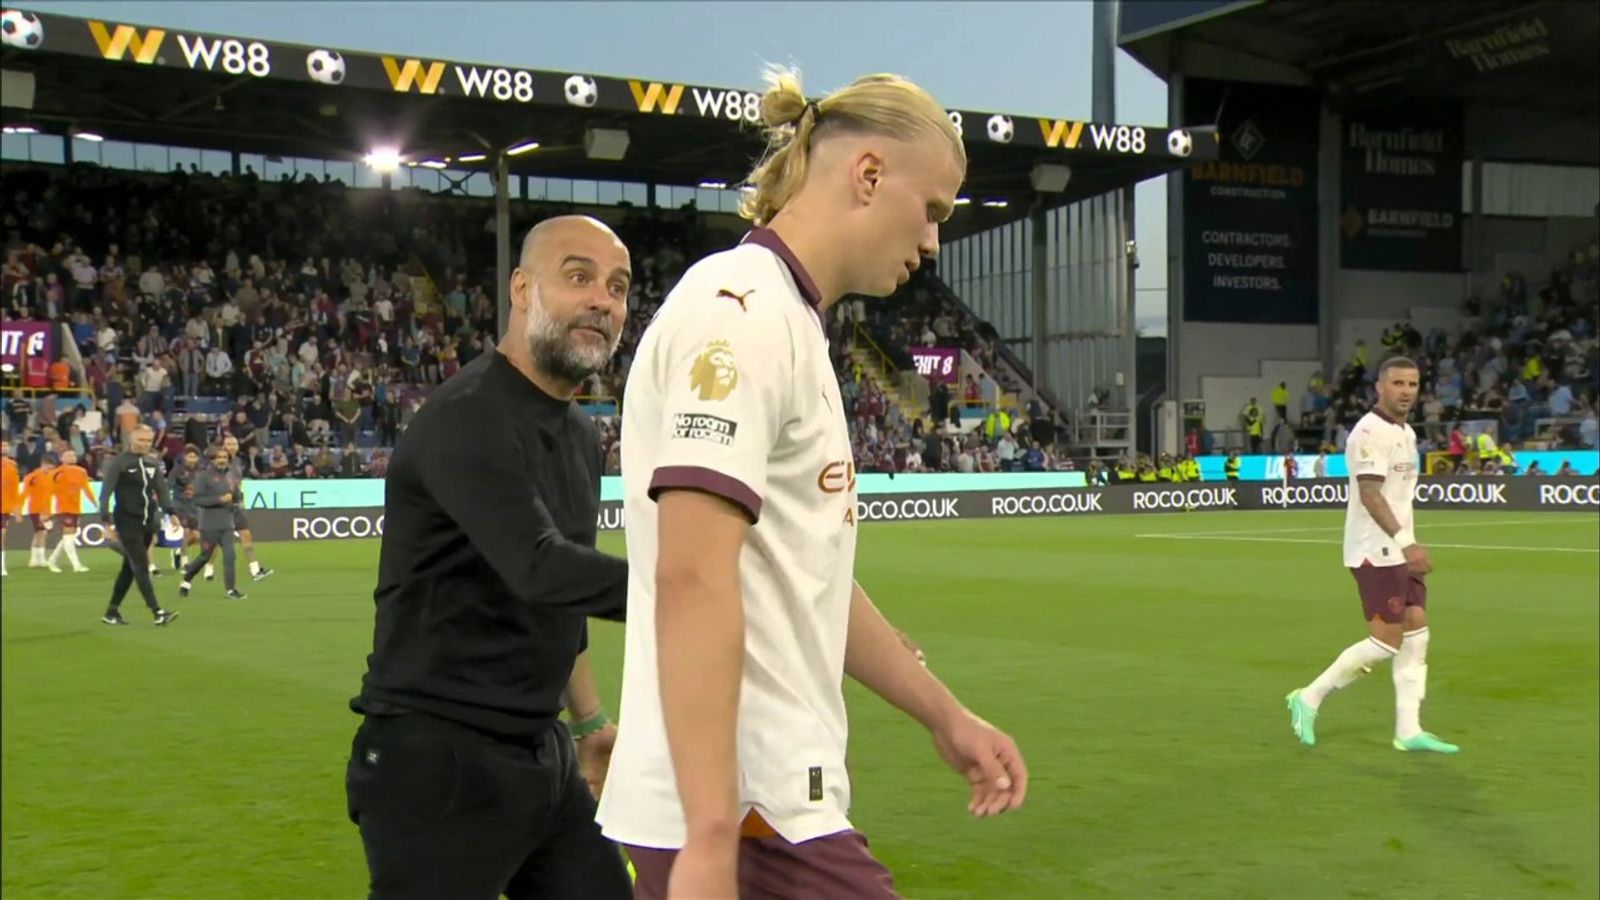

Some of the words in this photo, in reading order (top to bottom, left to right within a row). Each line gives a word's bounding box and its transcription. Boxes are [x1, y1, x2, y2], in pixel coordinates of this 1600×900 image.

[177, 35, 270, 77] W88
[455, 66, 533, 102] W88
[692, 88, 760, 122] W88
[1090, 124, 1146, 154] W88
[1191, 161, 1305, 187] BARNFIELD
[1210, 186, 1286, 199] CONSTRUCTION
[1368, 208, 1454, 228] BARNFIELD
[1213, 275, 1282, 290] INVESTORS.
[27, 331, 45, 355] 6
[942, 355, 954, 375] 8
[692, 416, 730, 434] room
[992, 493, 1102, 515] ROCO.CO.UK
[1134, 488, 1238, 509] ROCO.CO.UK
